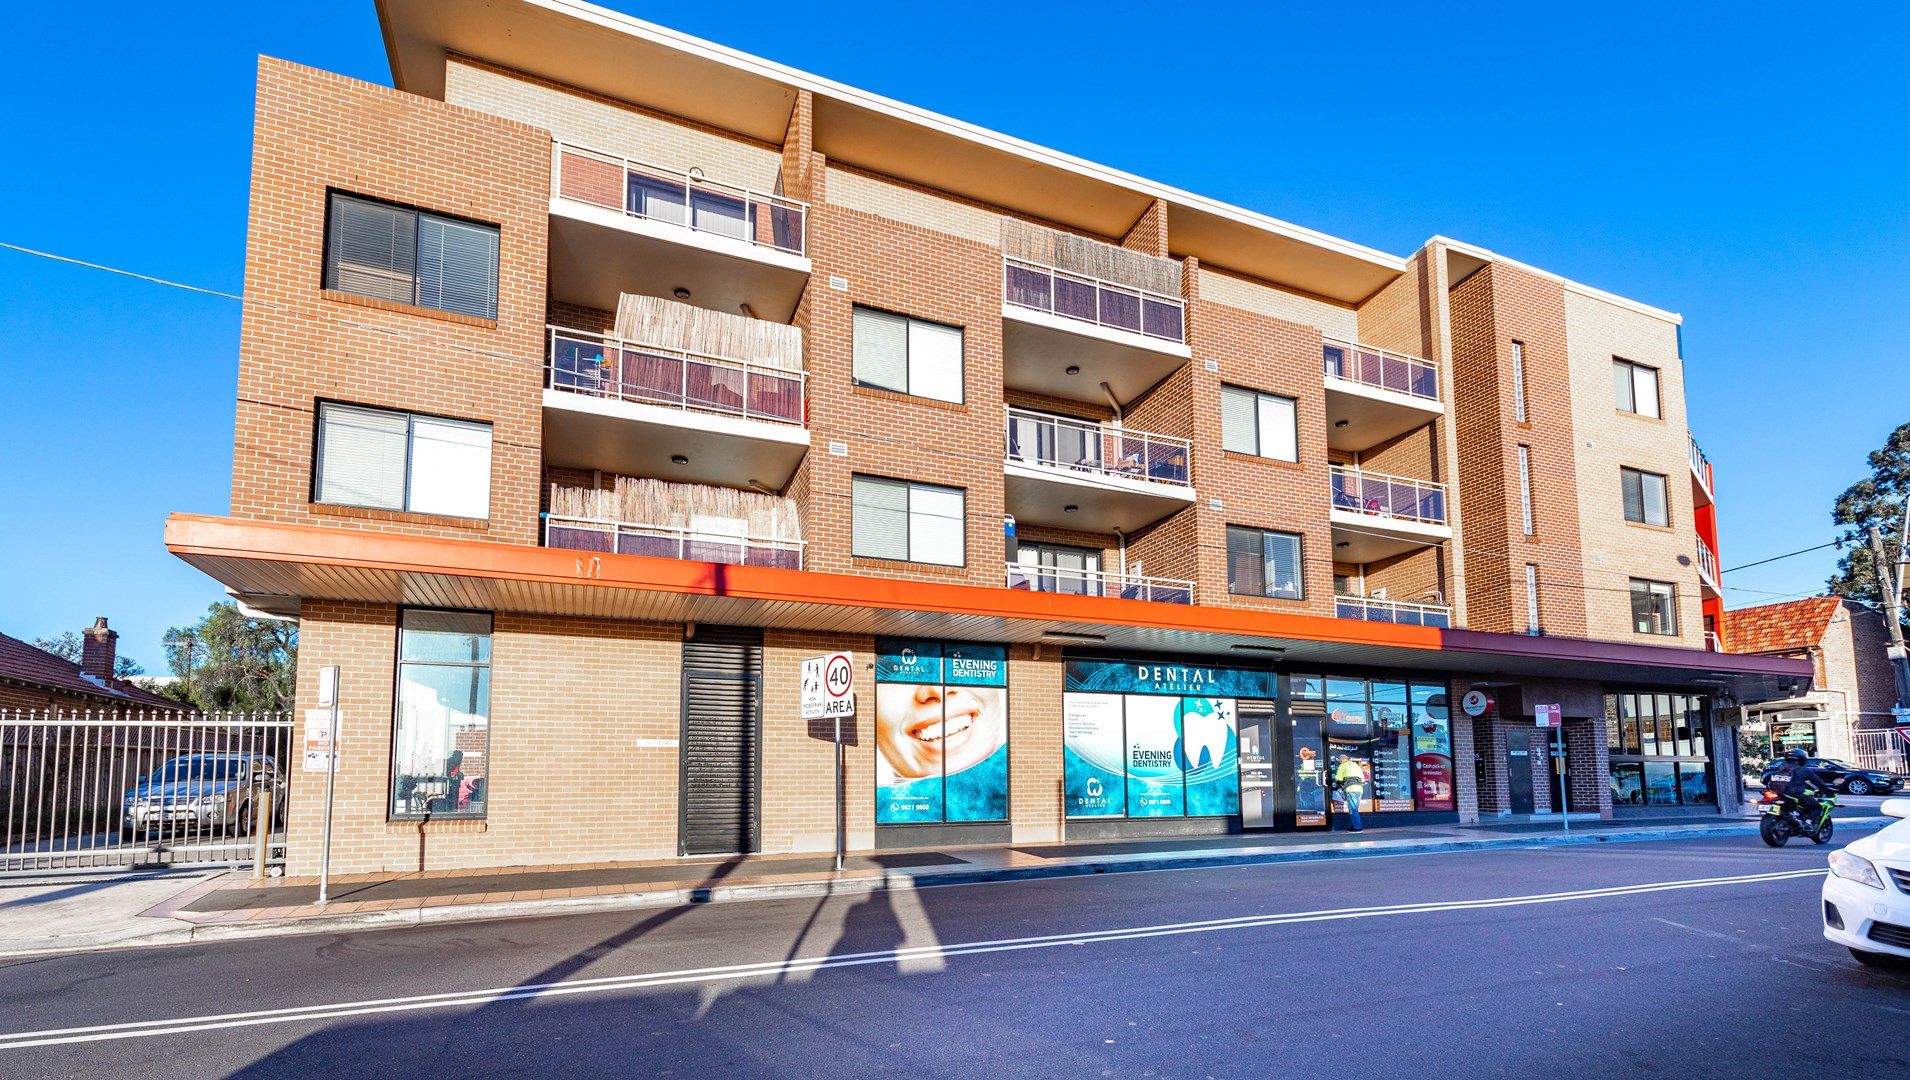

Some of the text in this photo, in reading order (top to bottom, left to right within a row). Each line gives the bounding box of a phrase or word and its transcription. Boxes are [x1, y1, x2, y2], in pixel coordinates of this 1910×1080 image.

[893, 664, 925, 673] DENTAL
[953, 659, 997, 670] EVENING
[829, 666, 848, 686] 40
[953, 668, 996, 678] DENTISTRY
[1138, 666, 1215, 683] DENTAL
[1154, 682, 1201, 691] ATELIER
[825, 700, 853, 714] AREA
[1132, 750, 1172, 760] EVENING
[1132, 760, 1172, 768] DENTISTRY
[1078, 797, 1112, 805] DENTAL
